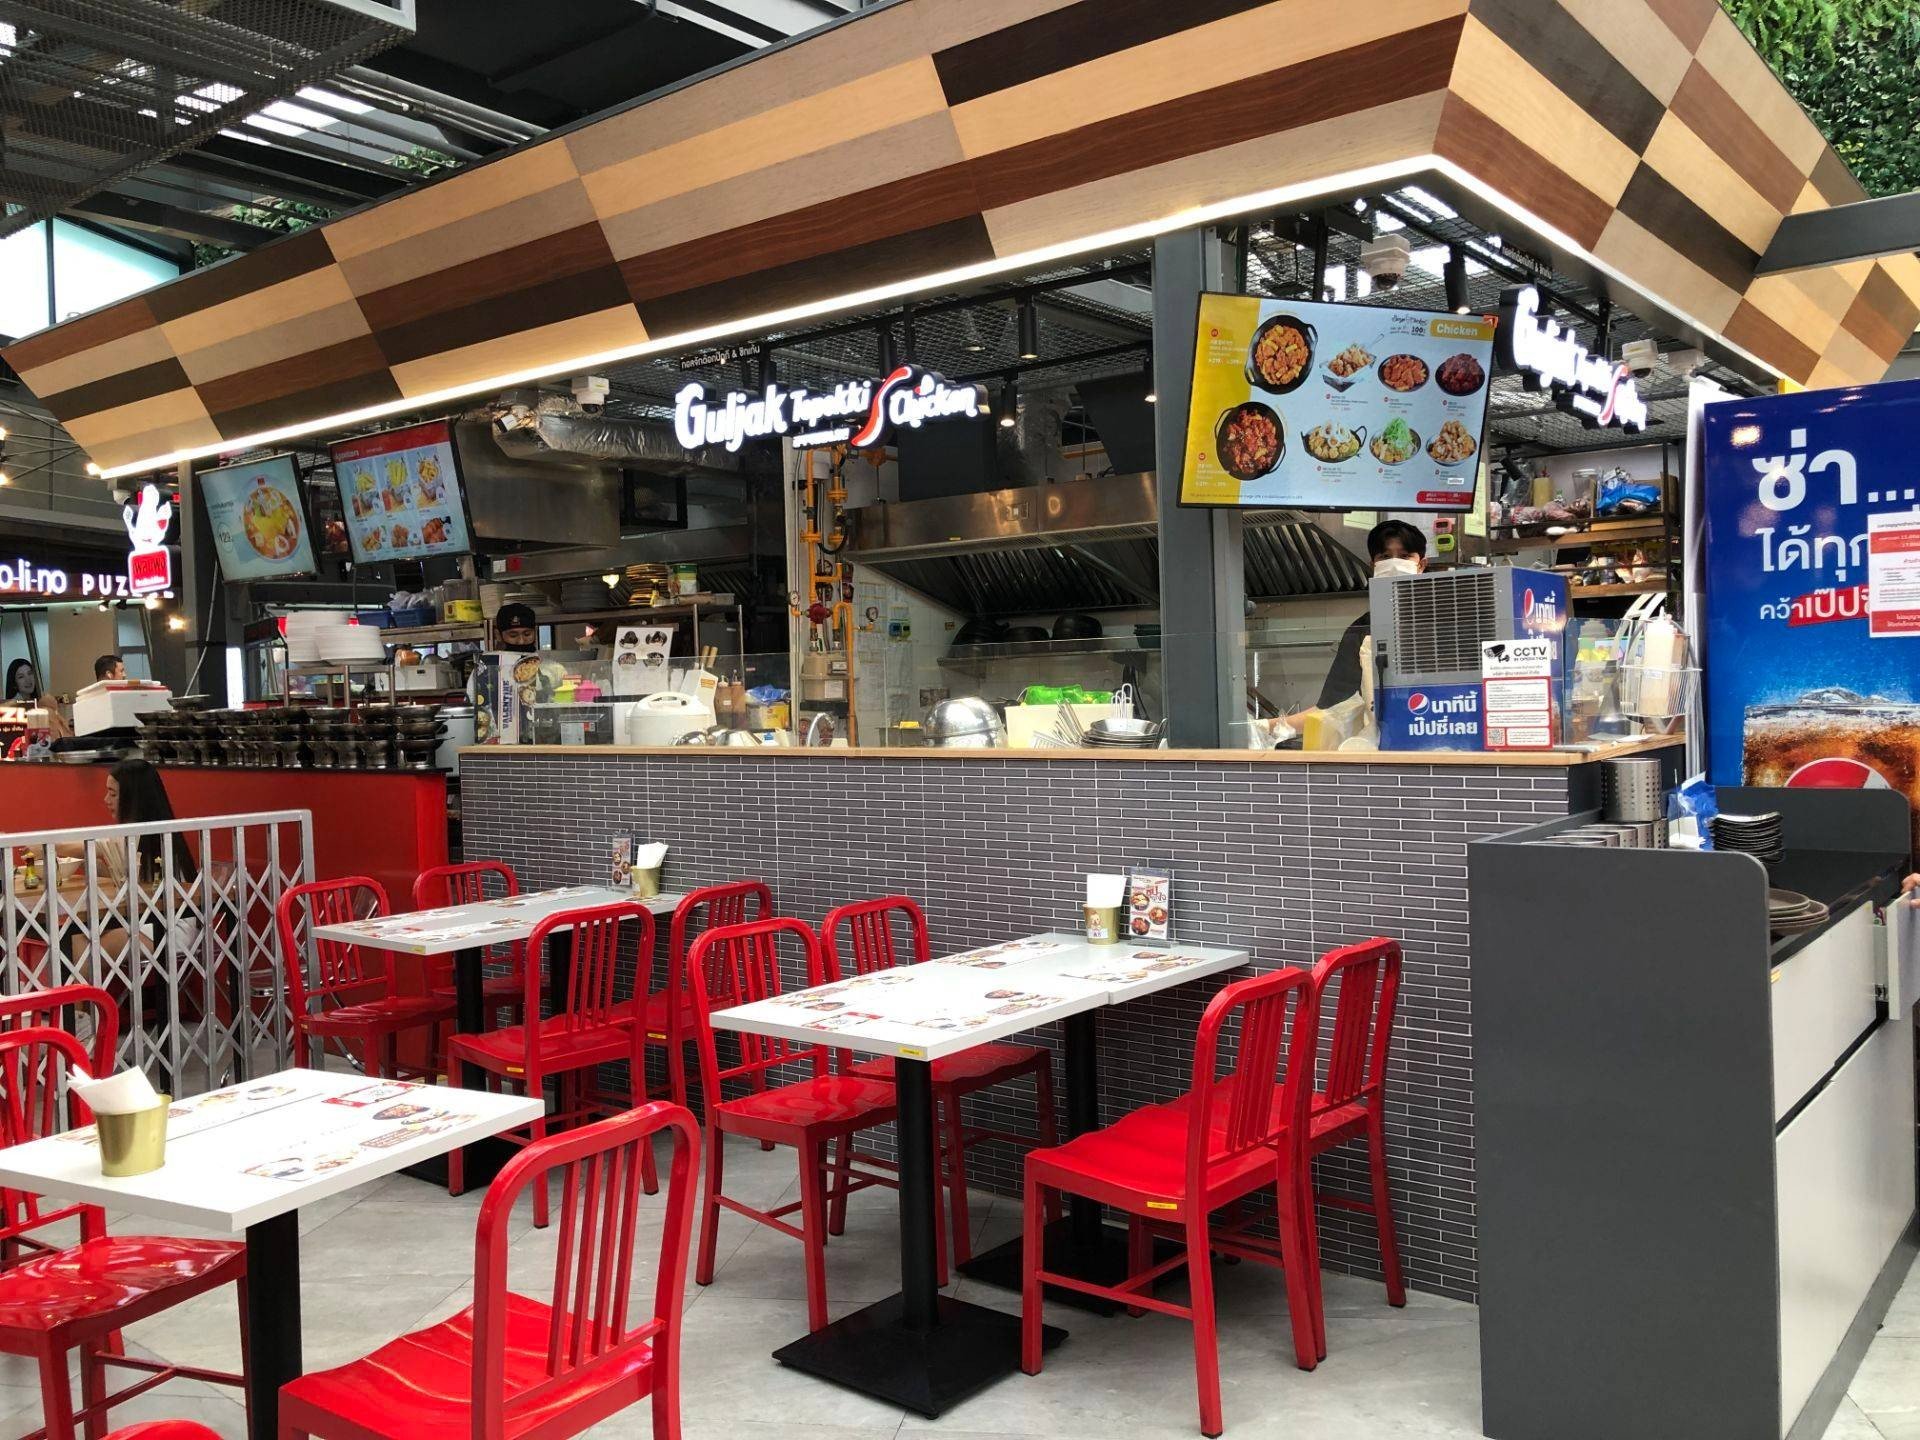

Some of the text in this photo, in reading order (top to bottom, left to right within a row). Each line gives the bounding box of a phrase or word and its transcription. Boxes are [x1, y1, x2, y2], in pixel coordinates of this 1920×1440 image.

[1436, 323, 1478, 336] Chicken
[731, 349, 738, 358] &
[674, 382, 788, 452] Guljak
[1513, 646, 1547, 657] CCTV
[1431, 690, 1478, 713] นาทีนี้
[1408, 715, 1478, 736] เป๊ปซี่เลย
